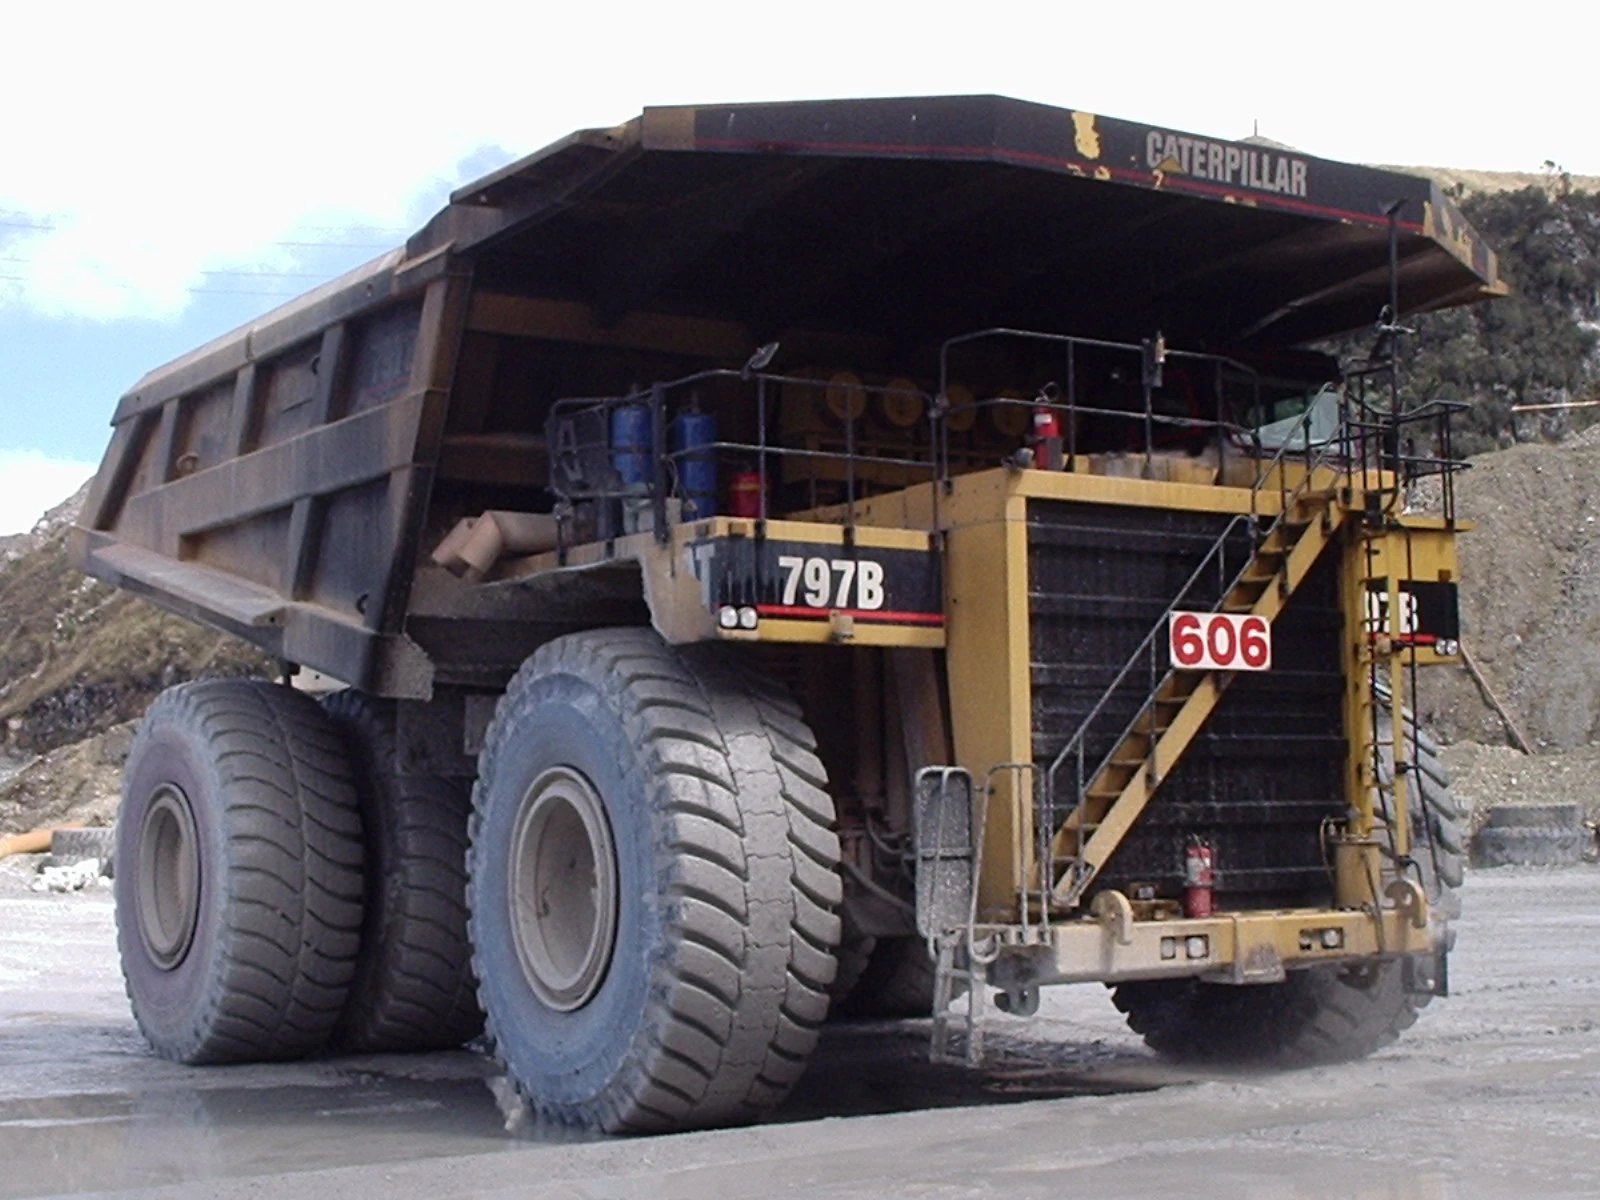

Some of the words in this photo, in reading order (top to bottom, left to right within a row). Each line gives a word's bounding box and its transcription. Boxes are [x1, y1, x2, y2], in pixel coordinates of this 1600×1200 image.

[1145, 130, 1307, 197] CATERPILLAR
[778, 556, 885, 610] 797B
[1172, 614, 1269, 668] 606
